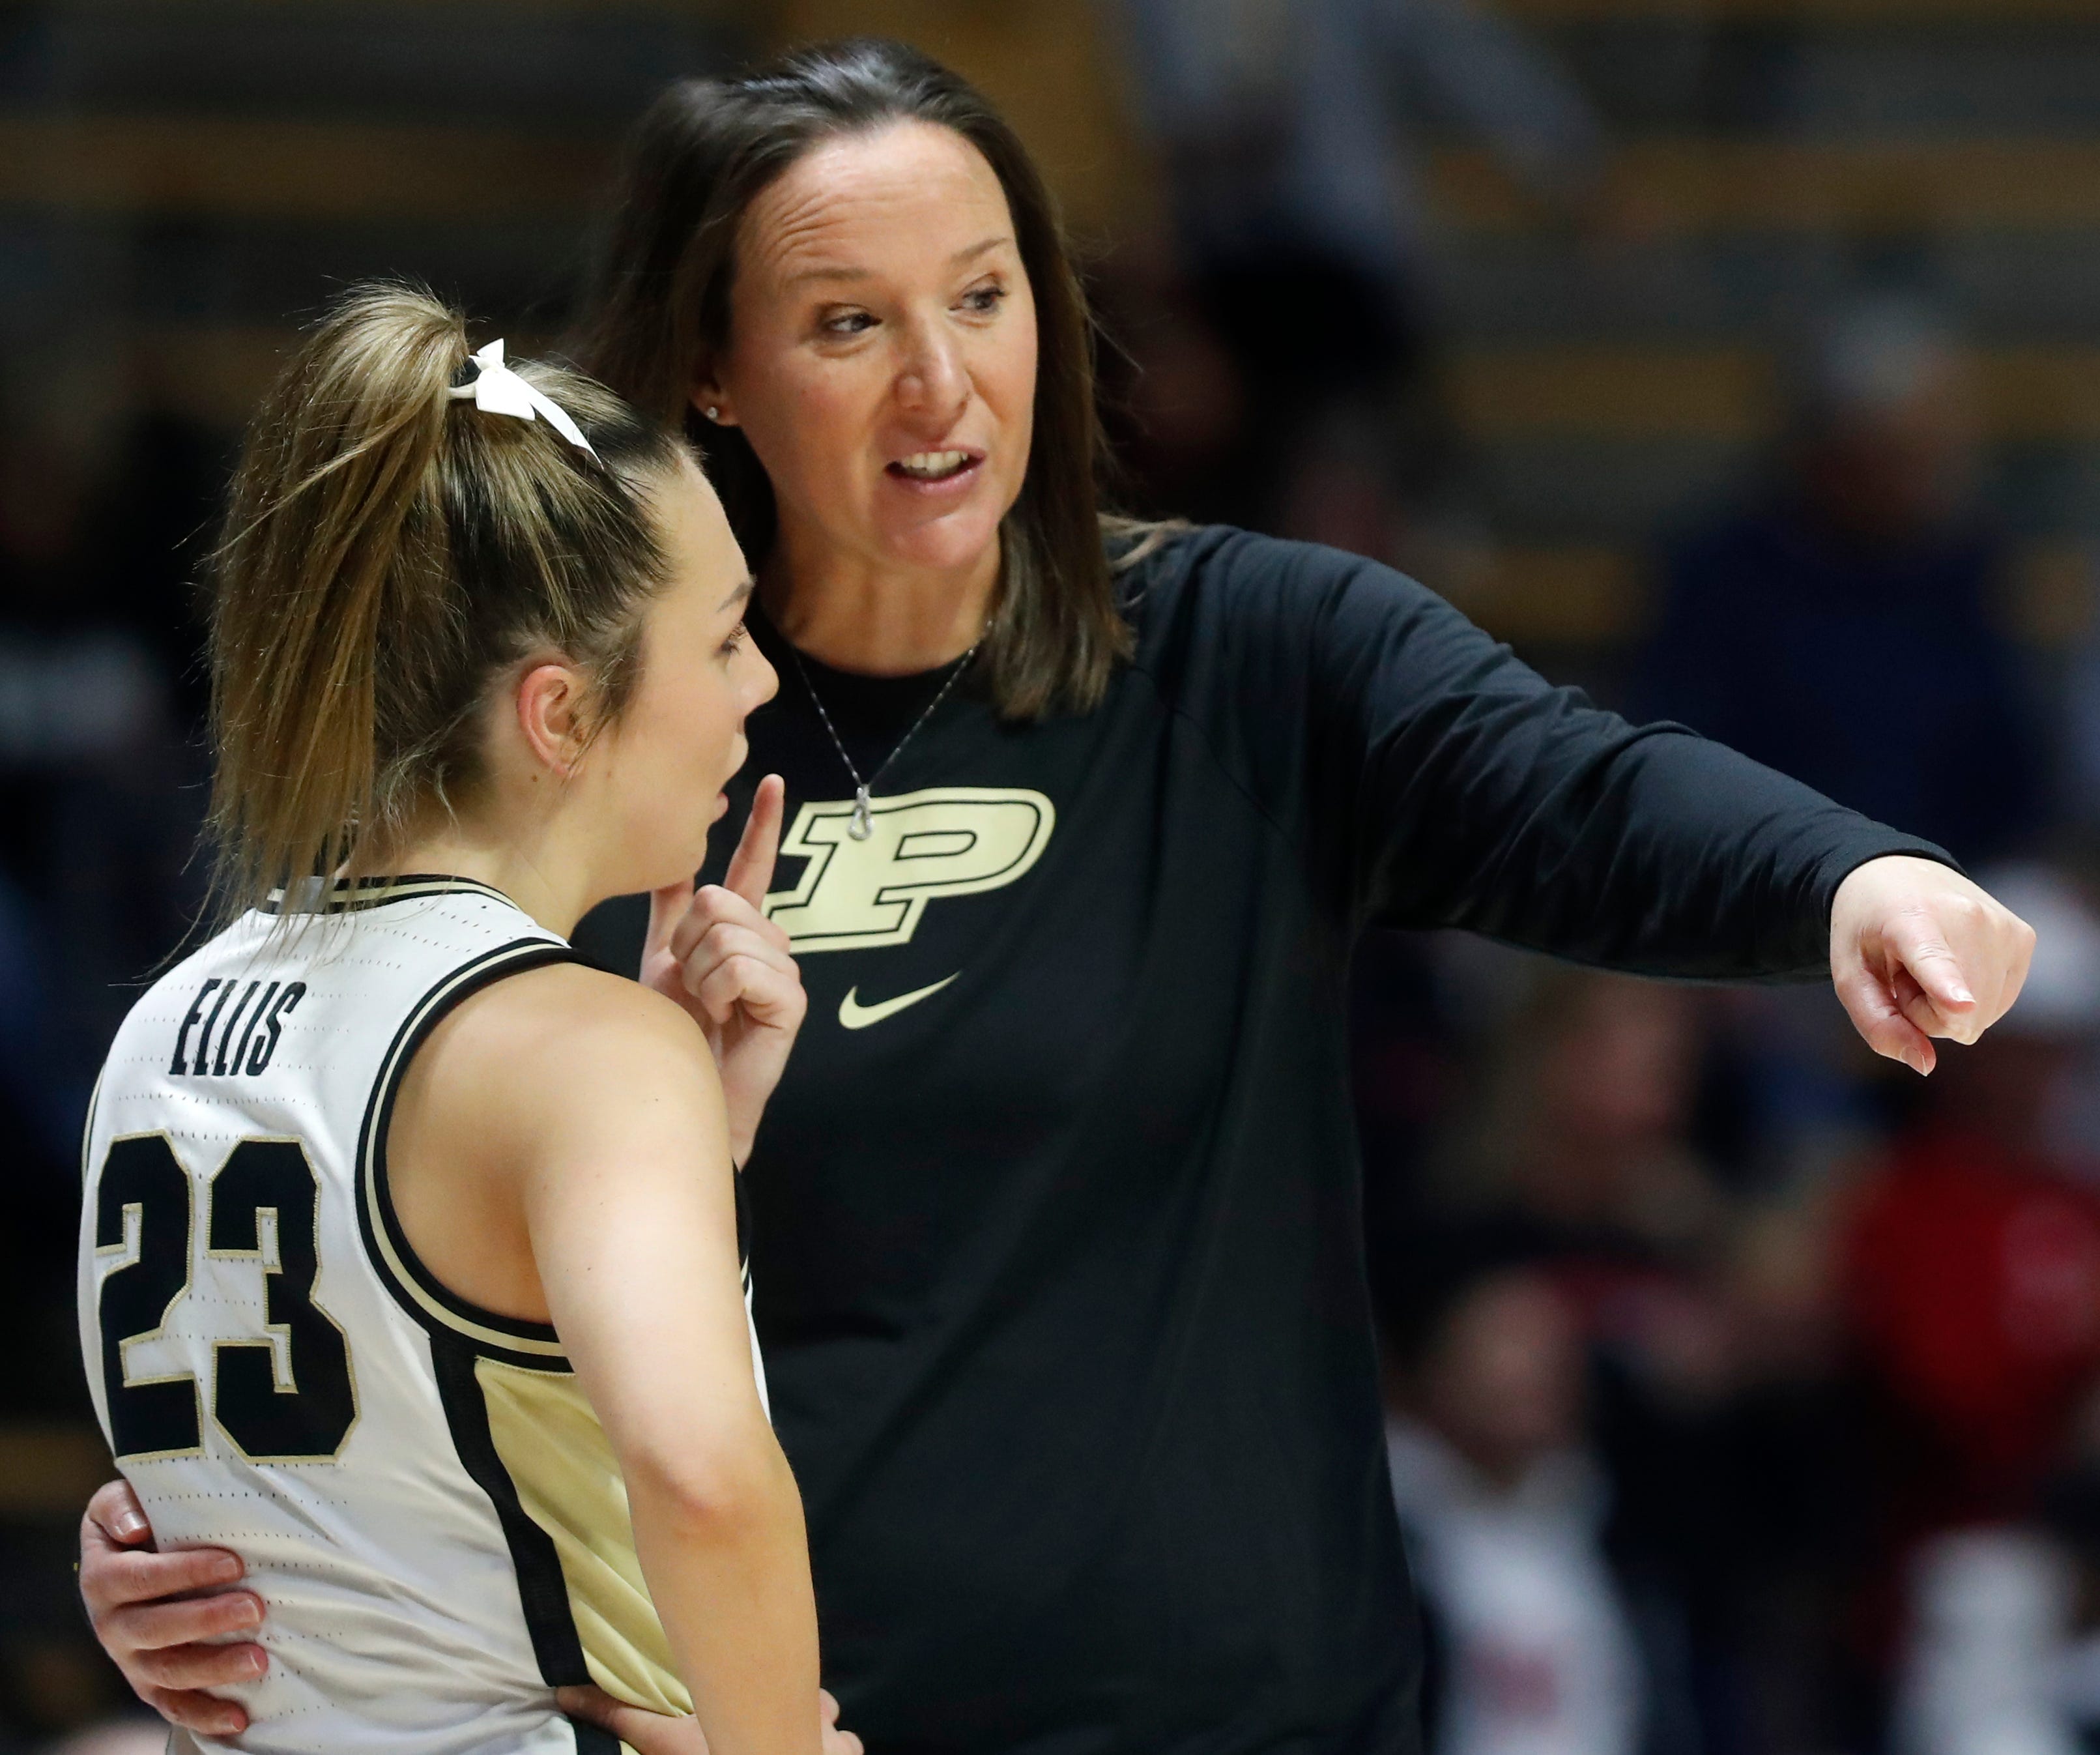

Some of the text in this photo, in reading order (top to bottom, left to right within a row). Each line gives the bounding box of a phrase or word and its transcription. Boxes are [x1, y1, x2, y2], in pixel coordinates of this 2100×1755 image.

[760, 787, 1056, 953] P
[169, 978, 306, 1076] ELLIS
[96, 1129, 361, 1464] 23
